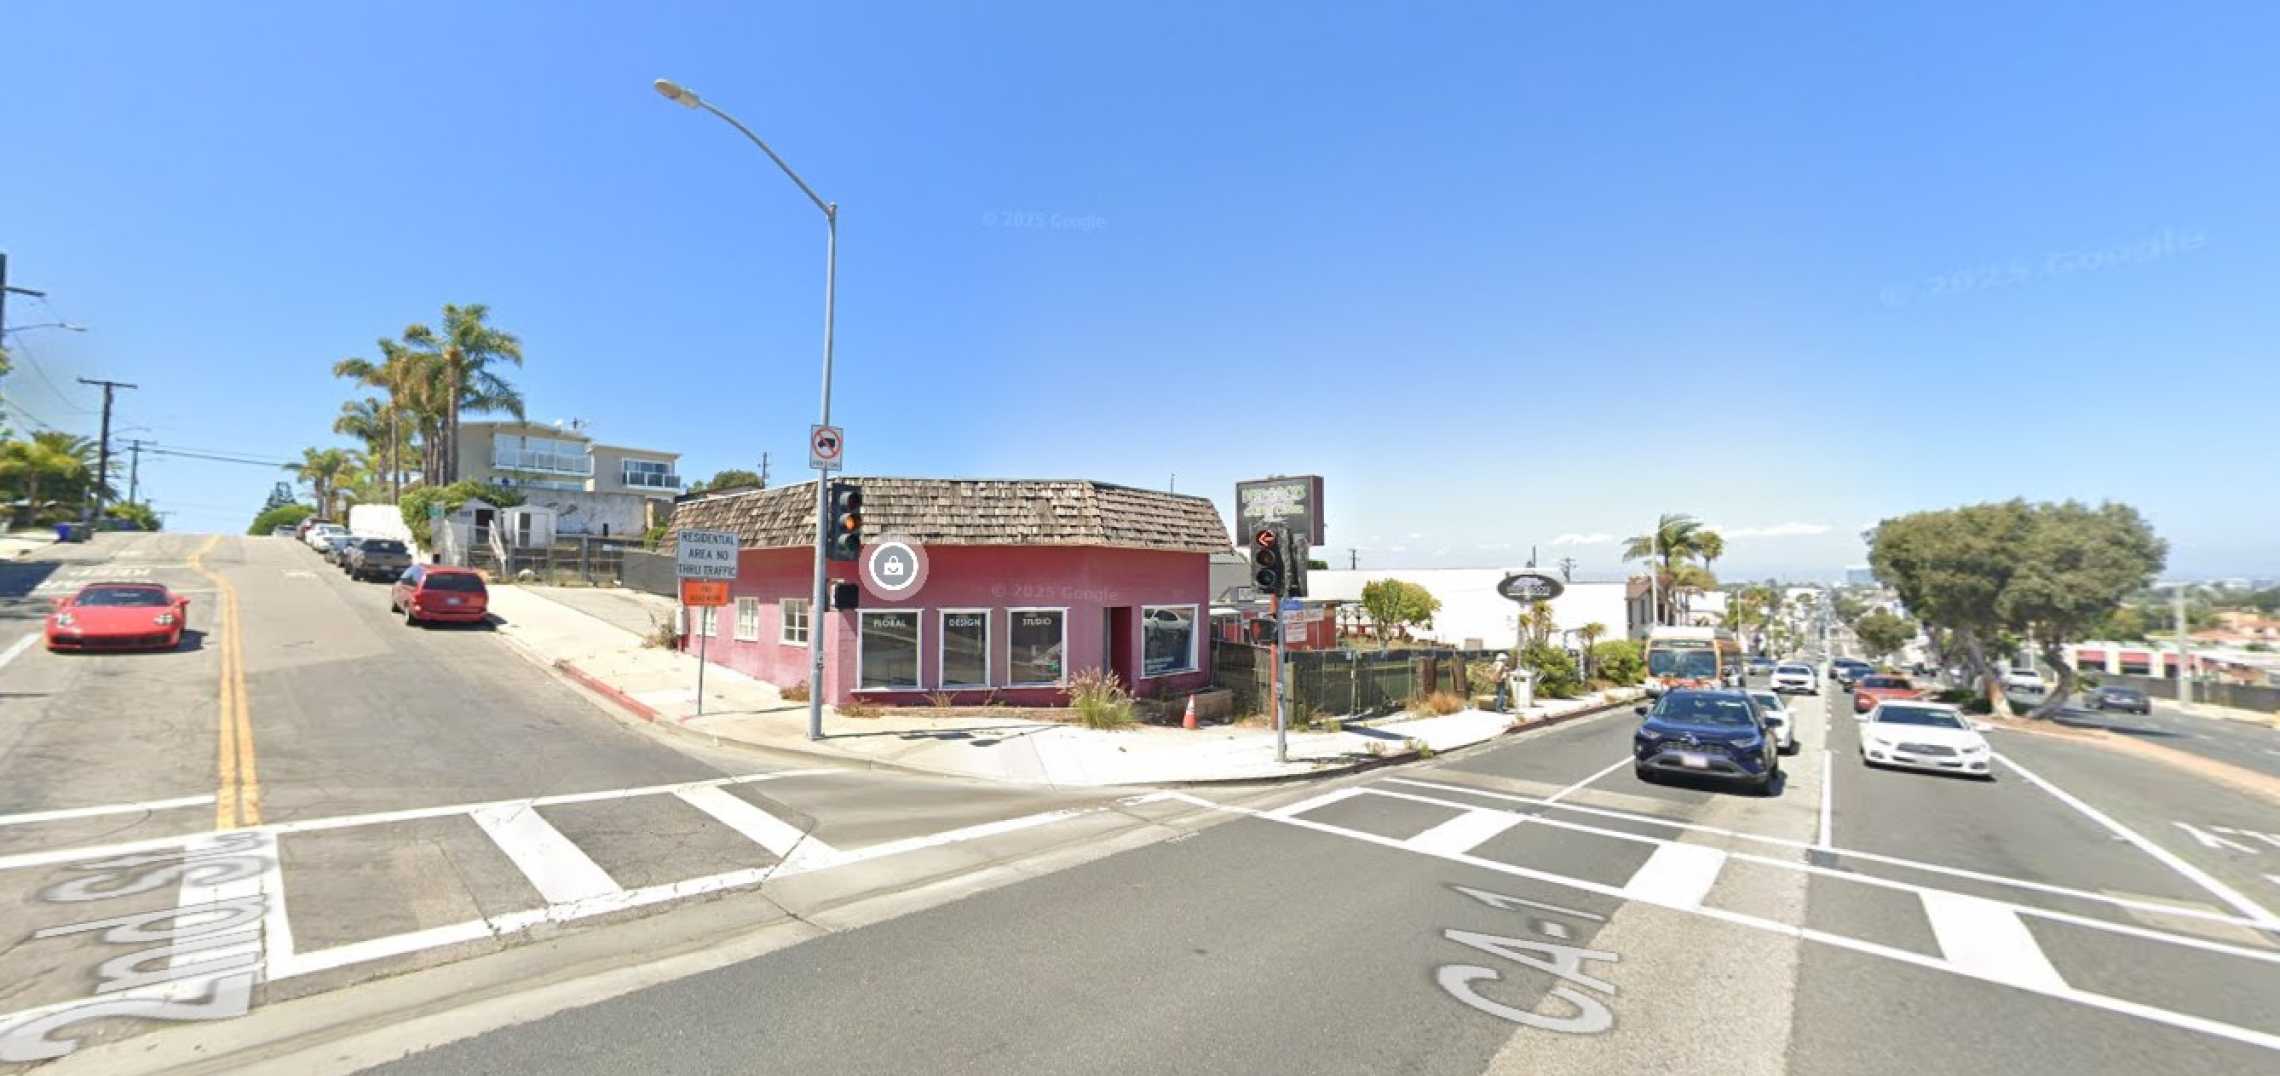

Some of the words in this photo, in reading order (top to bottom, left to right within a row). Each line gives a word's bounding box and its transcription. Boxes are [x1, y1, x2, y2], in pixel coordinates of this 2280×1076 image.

[681, 532, 734, 545] RESIDENTIAL
[688, 549, 713, 560] AREA
[717, 551, 729, 561] NO
[680, 564, 702, 574] THRU
[704, 566, 736, 576] TRAFFIC
[874, 619, 906, 628] FLORAL
[949, 618, 981, 627] DESIGN
[1022, 617, 1052, 626] STUDIO
